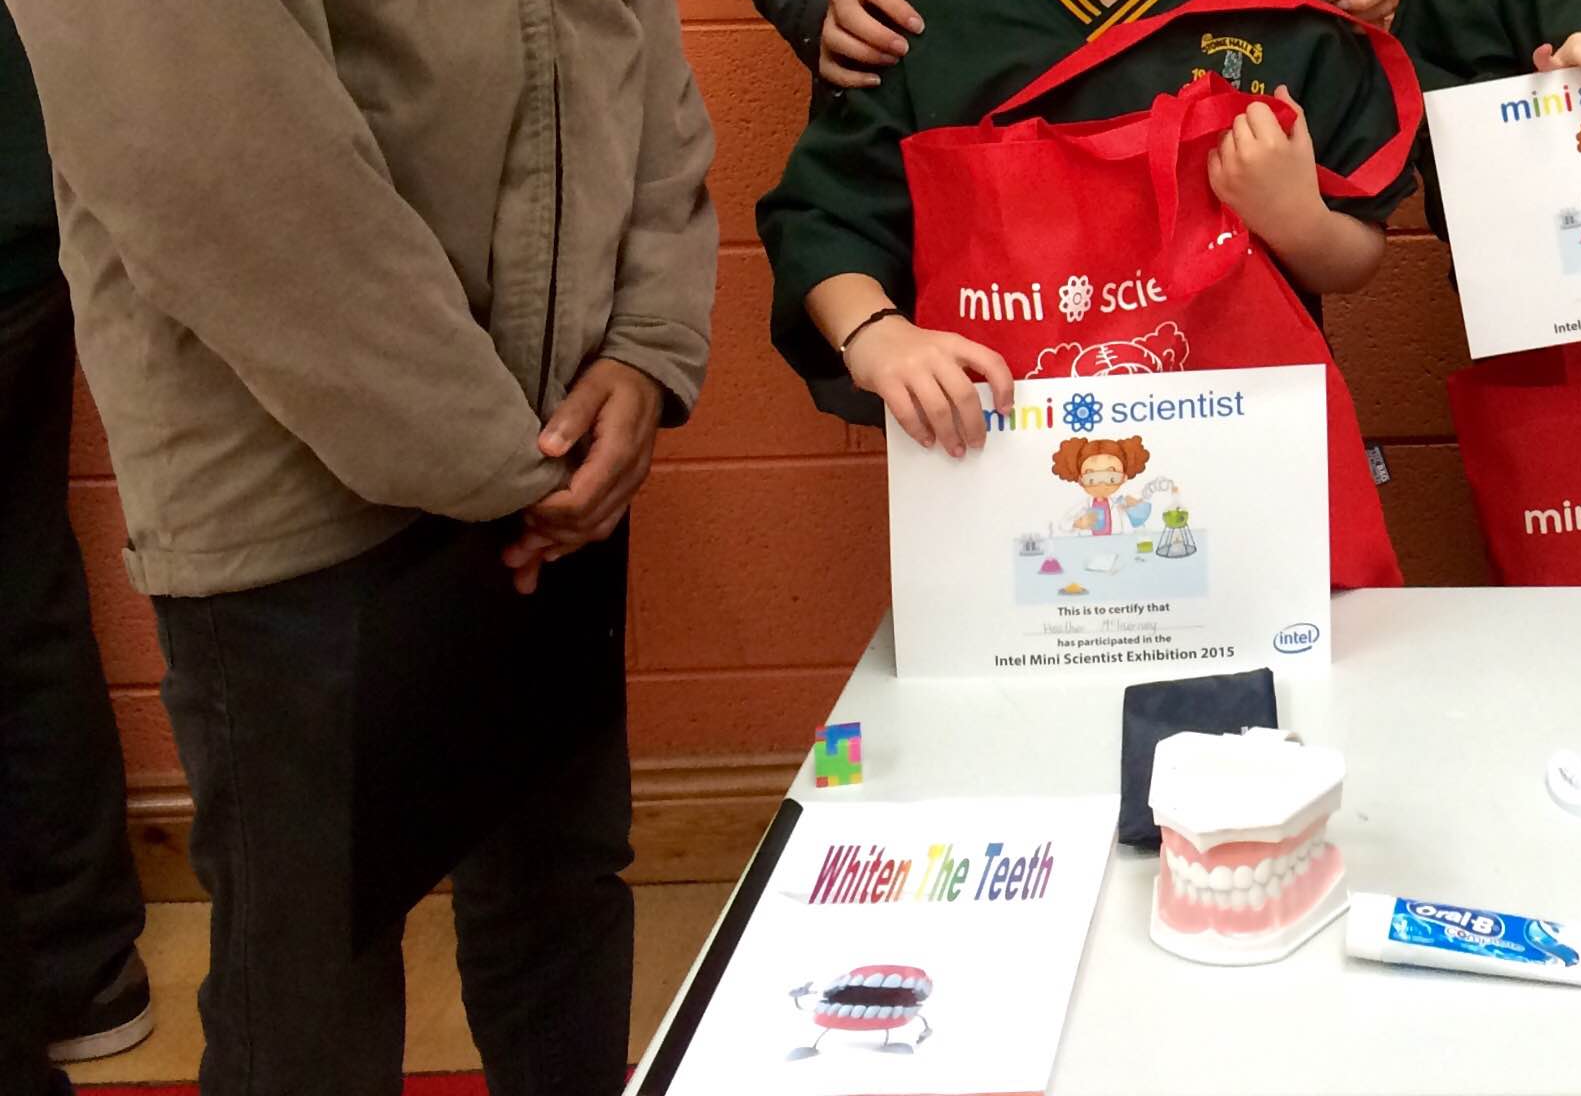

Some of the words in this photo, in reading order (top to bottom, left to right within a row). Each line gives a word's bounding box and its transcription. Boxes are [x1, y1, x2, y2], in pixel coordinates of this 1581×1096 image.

[1501, 85, 1572, 123] mini
[959, 282, 1044, 321] mini
[1554, 319, 1581, 334] Intel
[1111, 391, 1245, 423] scientist
[1057, 607, 1080, 617] This
[1083, 606, 1092, 615] is
[1093, 606, 1106, 615] to
[1108, 604, 1144, 615] certify
[1147, 603, 1170, 613] that
[1057, 638, 1075, 647] has
[1078, 635, 1140, 648] participated
[1143, 635, 1152, 644] in
[1154, 634, 1172, 644] the
[1278, 629, 1313, 646] intel
[995, 654, 1026, 667] Intel
[1030, 653, 1060, 666] Mini
[1064, 651, 1123, 665] Scientist
[1127, 648, 1197, 662] Exhibition
[1201, 646, 1235, 659] 2015
[808, 845, 913, 904] Whiten
[913, 843, 969, 902] The
[974, 842, 1054, 901] Teeth
[1415, 903, 1494, 936] Oral-B
